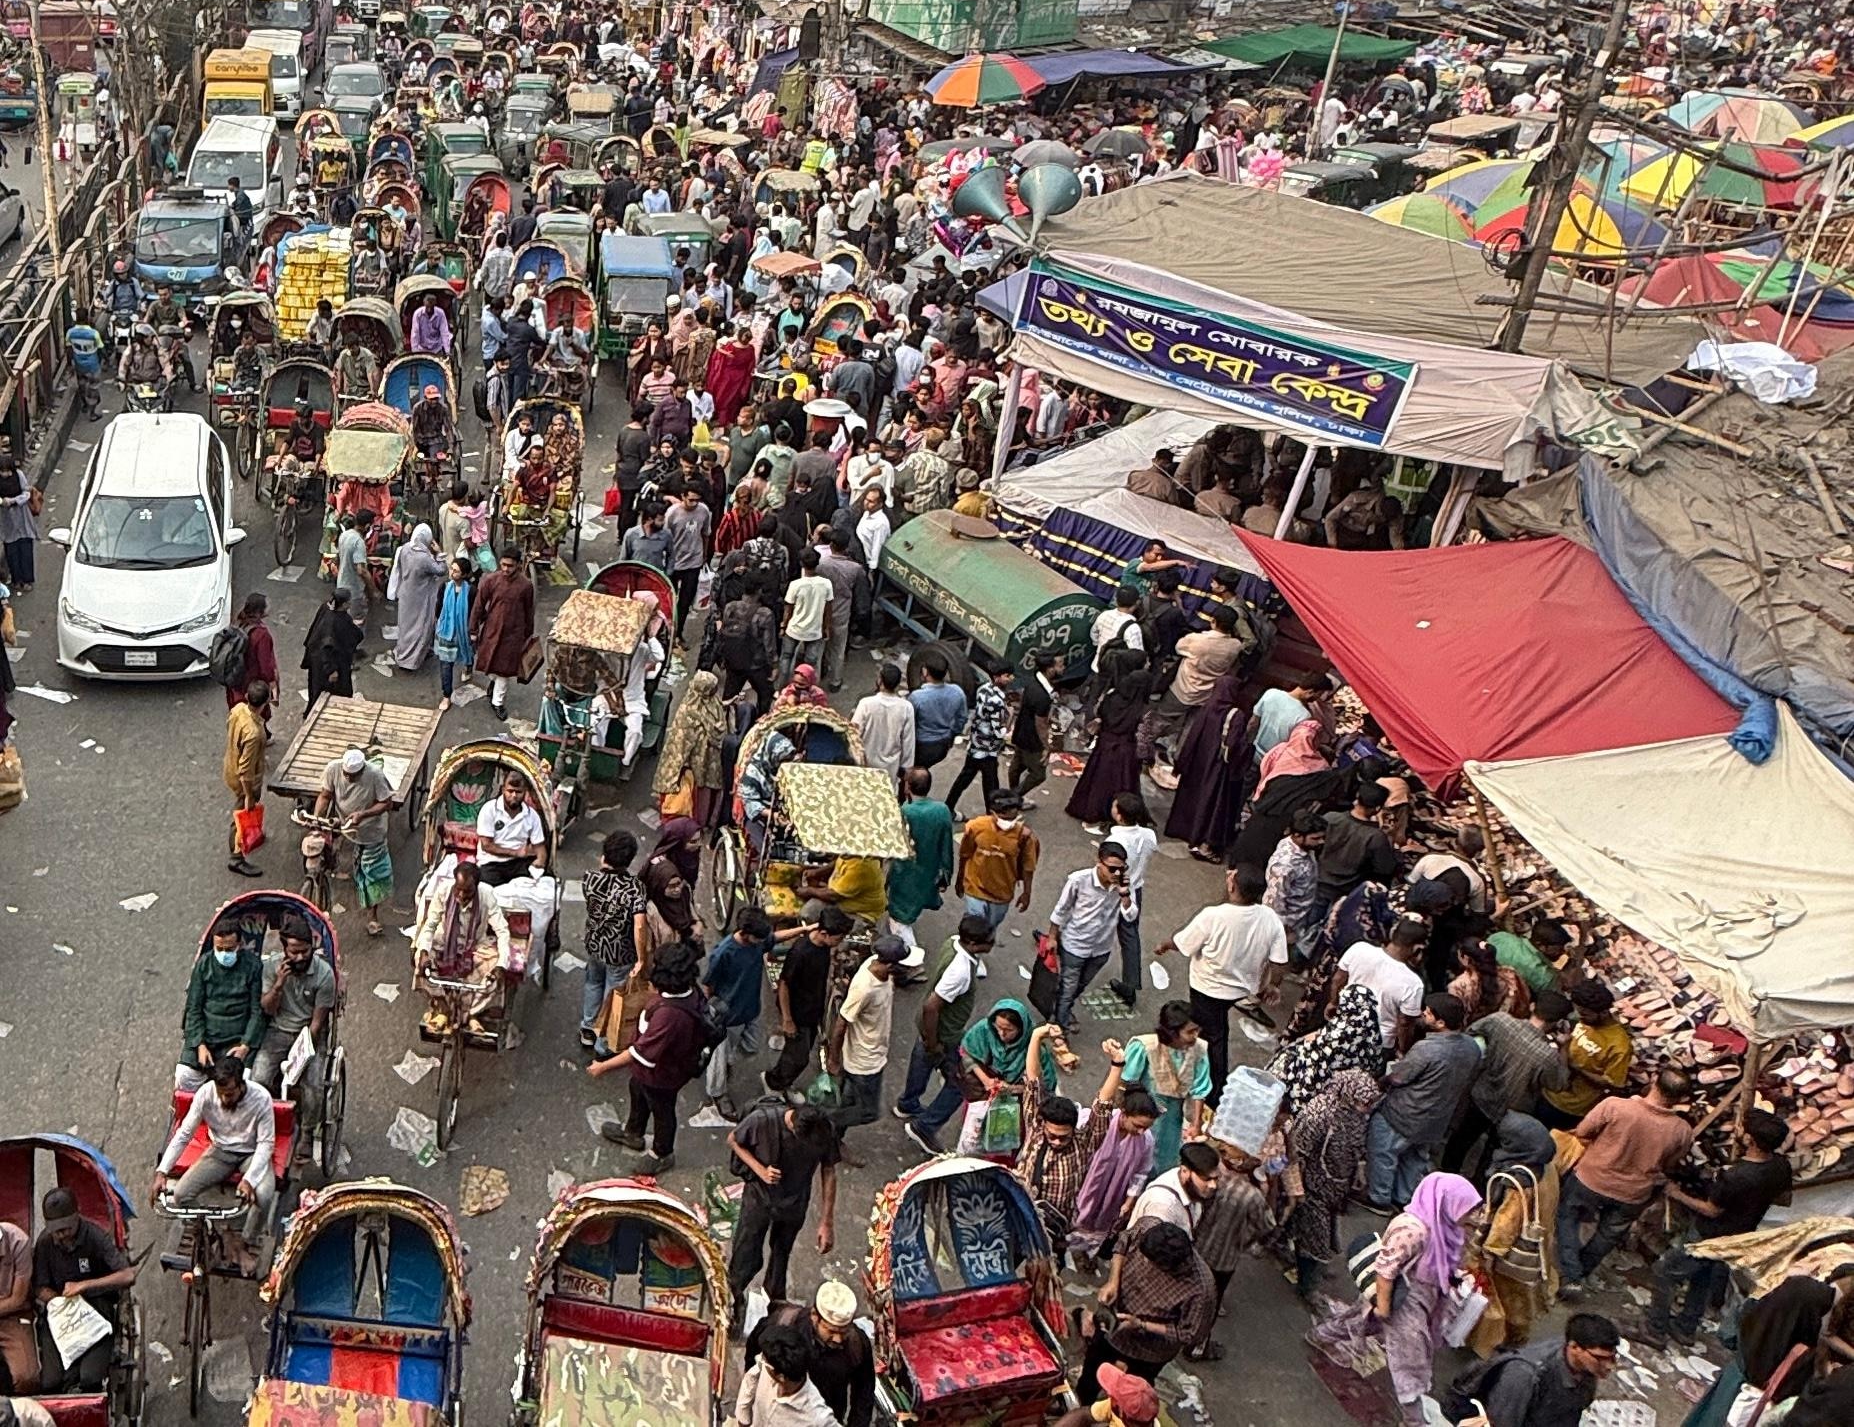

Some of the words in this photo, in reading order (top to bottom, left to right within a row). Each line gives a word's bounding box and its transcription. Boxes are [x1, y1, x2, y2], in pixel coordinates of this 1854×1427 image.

[1037, 296, 1114, 337] তথ্য
[1126, 328, 1154, 352] ও
[1168, 342, 1262, 384] সেবা
[1271, 372, 1377, 421] কেন্দ্র
[1095, 297, 1202, 335] রমজানুল
[1208, 330, 1322, 367] মোবারক
[1141, 363, 1172, 381] ঢাকা
[1175, 376, 1266, 409] মেট্রোপলিটন
[1327, 422, 1366, 439] ঢাকা
[1040, 624, 1071, 648] ৩৭
[1052, 604, 1089, 620] খাবার
